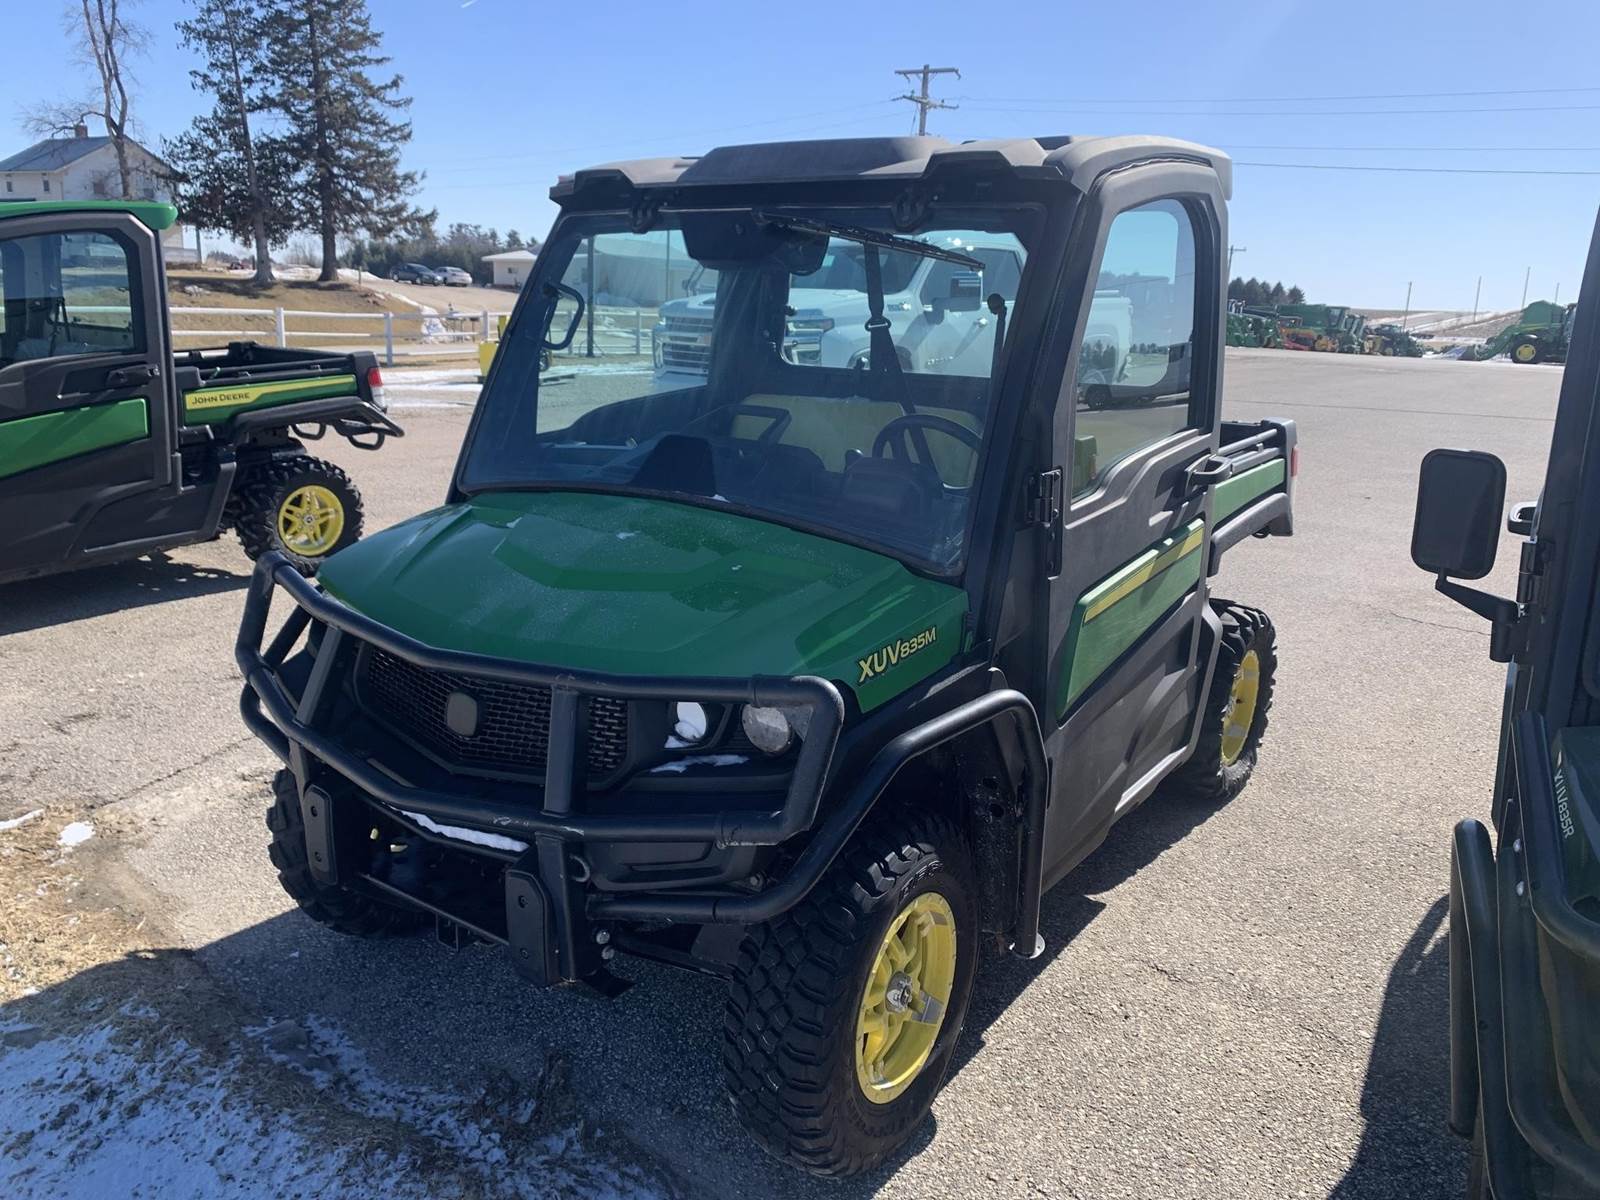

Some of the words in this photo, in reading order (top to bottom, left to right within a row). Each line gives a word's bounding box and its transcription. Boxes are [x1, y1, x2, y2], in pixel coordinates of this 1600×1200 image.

[192, 396, 217, 405] JOHN
[219, 392, 250, 401] DEERE
[858, 626, 937, 683] XUV835M
